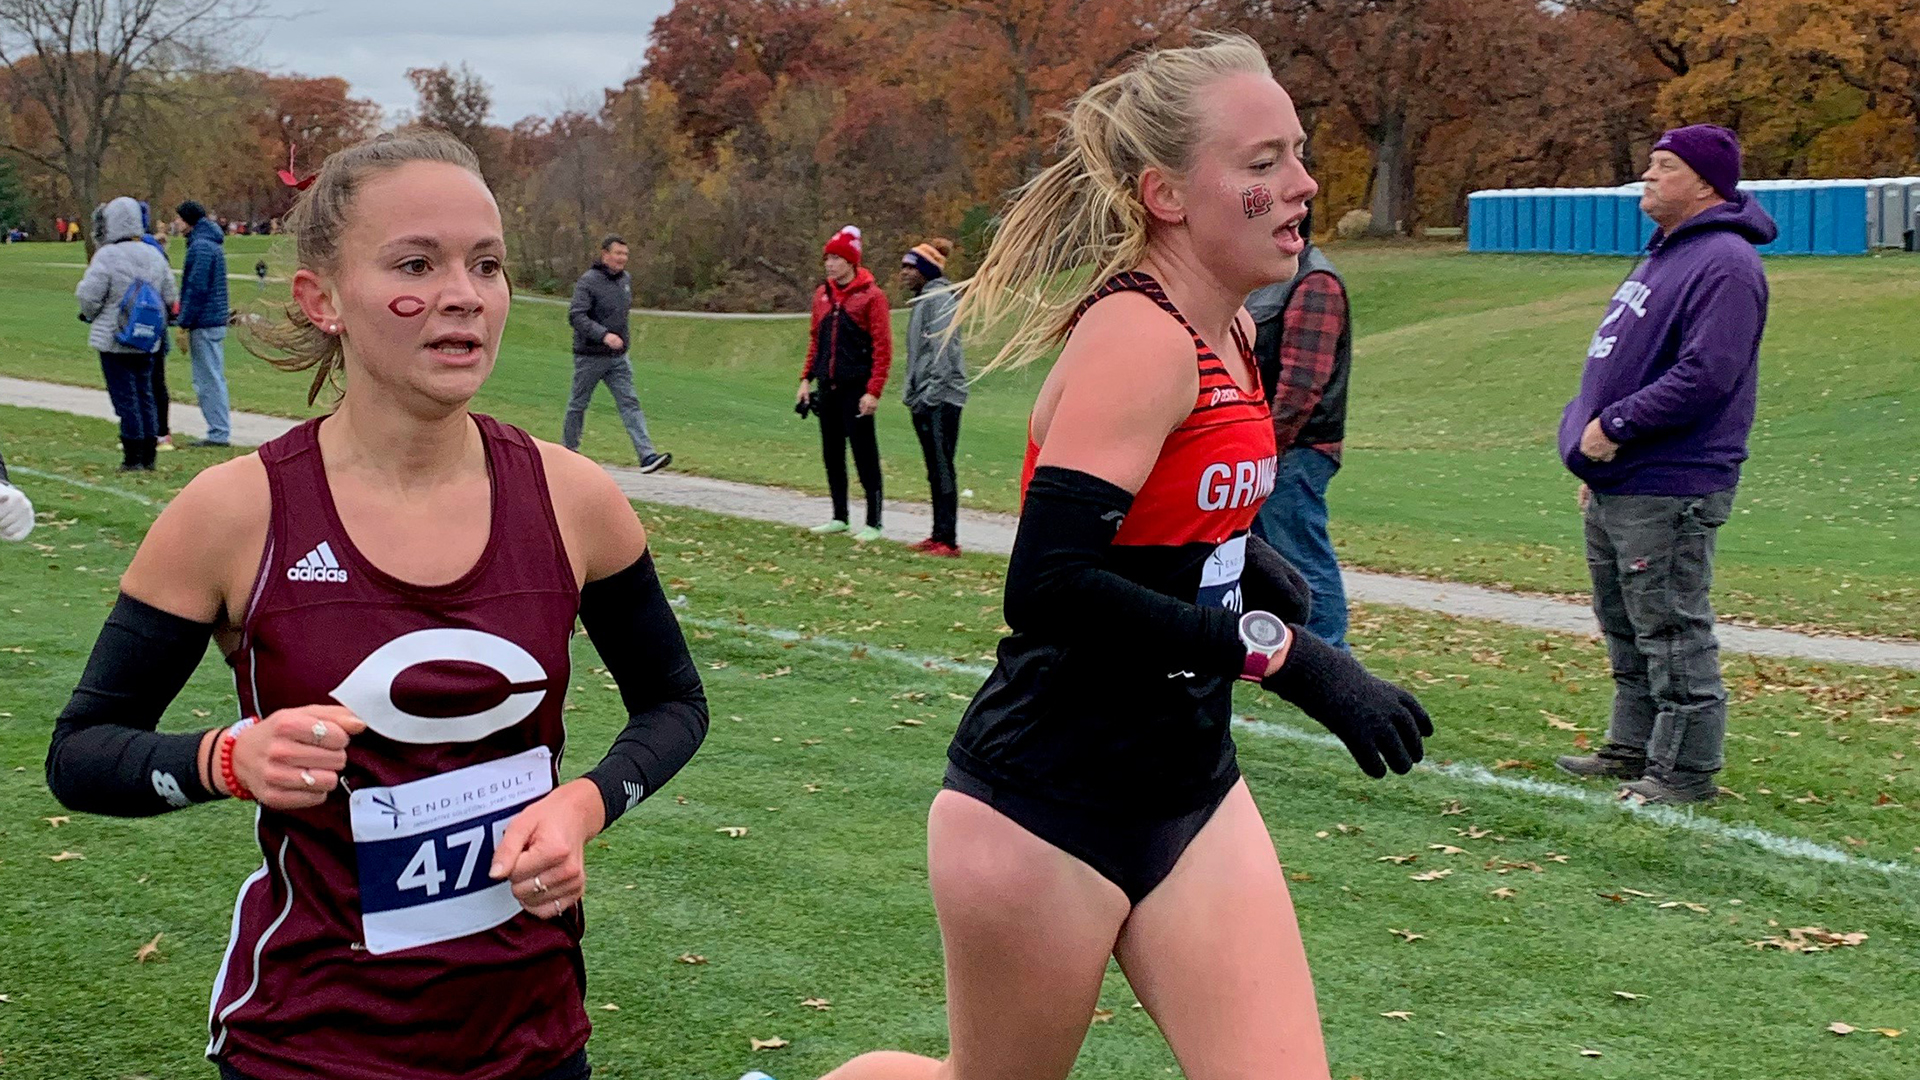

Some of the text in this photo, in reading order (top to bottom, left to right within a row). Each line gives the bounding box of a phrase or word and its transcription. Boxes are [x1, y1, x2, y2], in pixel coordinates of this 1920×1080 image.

[388, 295, 426, 317] C
[286, 565, 348, 583] adidas
[328, 628, 548, 744] C
